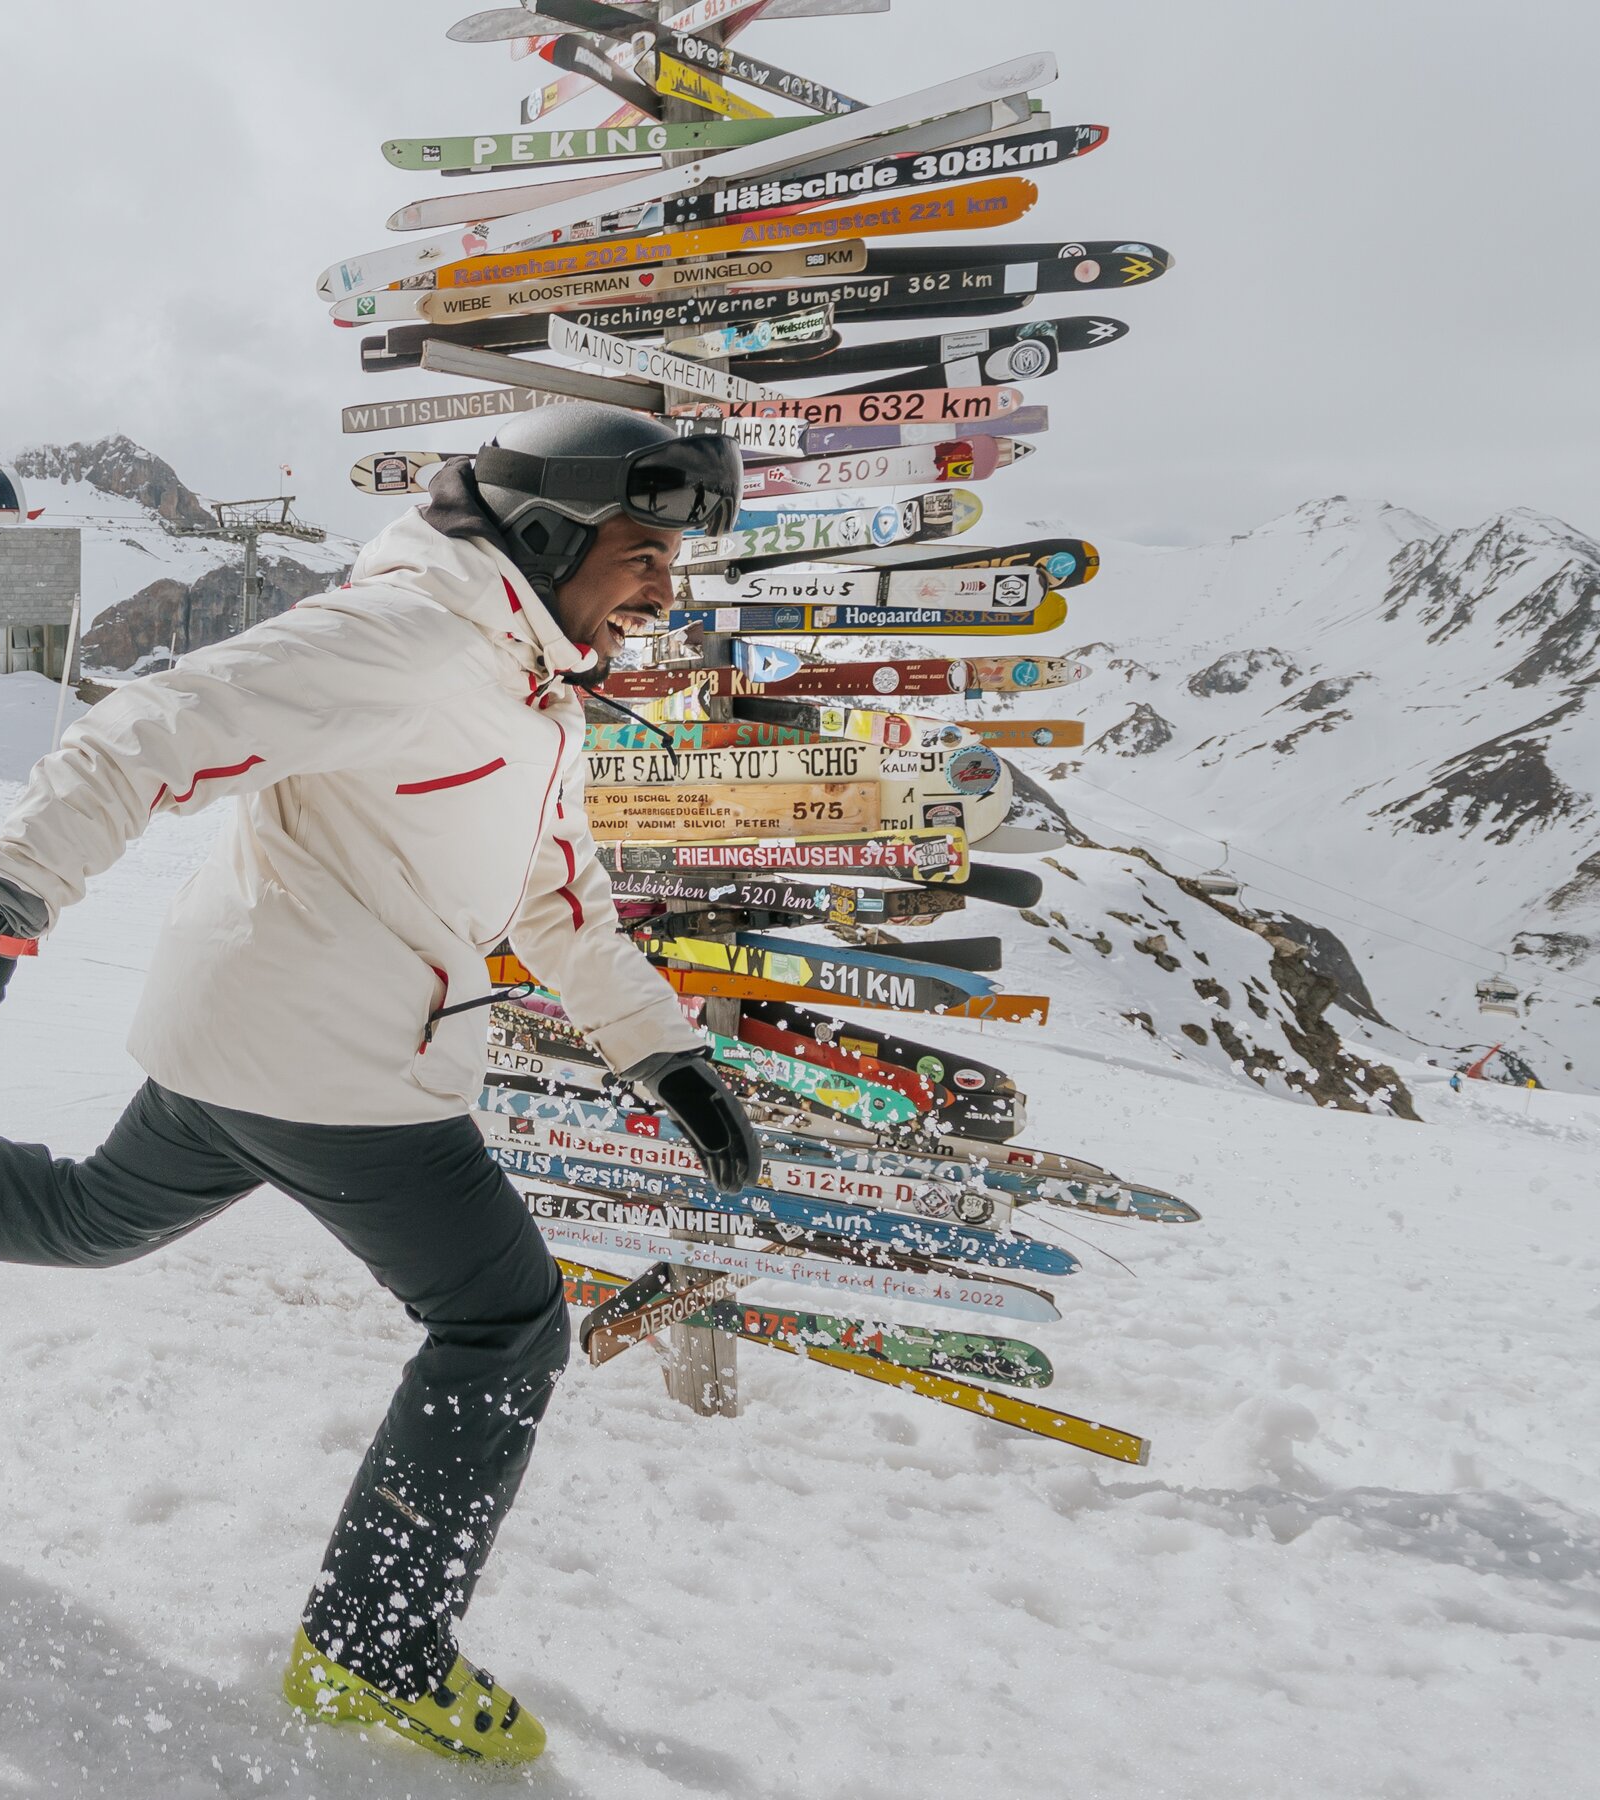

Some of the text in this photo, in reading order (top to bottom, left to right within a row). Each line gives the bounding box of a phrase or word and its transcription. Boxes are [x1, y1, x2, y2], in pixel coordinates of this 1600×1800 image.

[473, 127, 668, 164] PEKING
[713, 137, 1058, 214] Hääschde 308km
[740, 189, 1009, 245] Althengstett 221 km
[454, 241, 672, 285] Rattenharz 202 km
[443, 296, 491, 314] WIEBE
[508, 276, 630, 305] KLOOSTERMAN
[673, 260, 773, 285] DWINGELOO
[577, 271, 993, 328] Oischinger Werner Bumsbugl 362 km
[348, 390, 515, 430] WITTISLINGEN
[729, 400, 842, 425] Kltten
[859, 394, 925, 422] 632
[941, 392, 992, 418] km
[817, 456, 889, 485] 2509
[740, 520, 807, 558] 325
[844, 606, 942, 628] Hoegaarden
[943, 609, 975, 625] 583
[587, 754, 625, 783] WE
[632, 751, 723, 782] SALUTE
[786, 745, 867, 778] SCHG
[882, 763, 918, 775] KALM
[605, 795, 628, 804] YOU
[633, 794, 671, 803] ISCHGL
[677, 794, 709, 803] 2024!
[792, 801, 845, 820] 575
[591, 818, 781, 829] DAVID! VADIM! SILVIO! PETER!
[677, 845, 855, 868] RIELINGSHAUSEN
[860, 846, 897, 866] 375
[920, 852, 949, 867] TOUR
[740, 886, 776, 905] 520
[783, 892, 816, 910] km
[820, 961, 859, 998] 511
[866, 970, 916, 1008] KM
[786, 1169, 883, 1199] 512km
[895, 1184, 912, 1203] D
[575, 1199, 754, 1237] SCHWANHEIM
[614, 1235, 642, 1251] 525
[648, 1239, 673, 1257] km
[755, 1255, 785, 1276] the
[791, 1263, 831, 1283] first
[837, 1272, 875, 1290] and
[882, 1279, 952, 1301] frieds
[959, 1288, 1005, 1309] 2022
[638, 1279, 725, 1340] AEROCLUB
